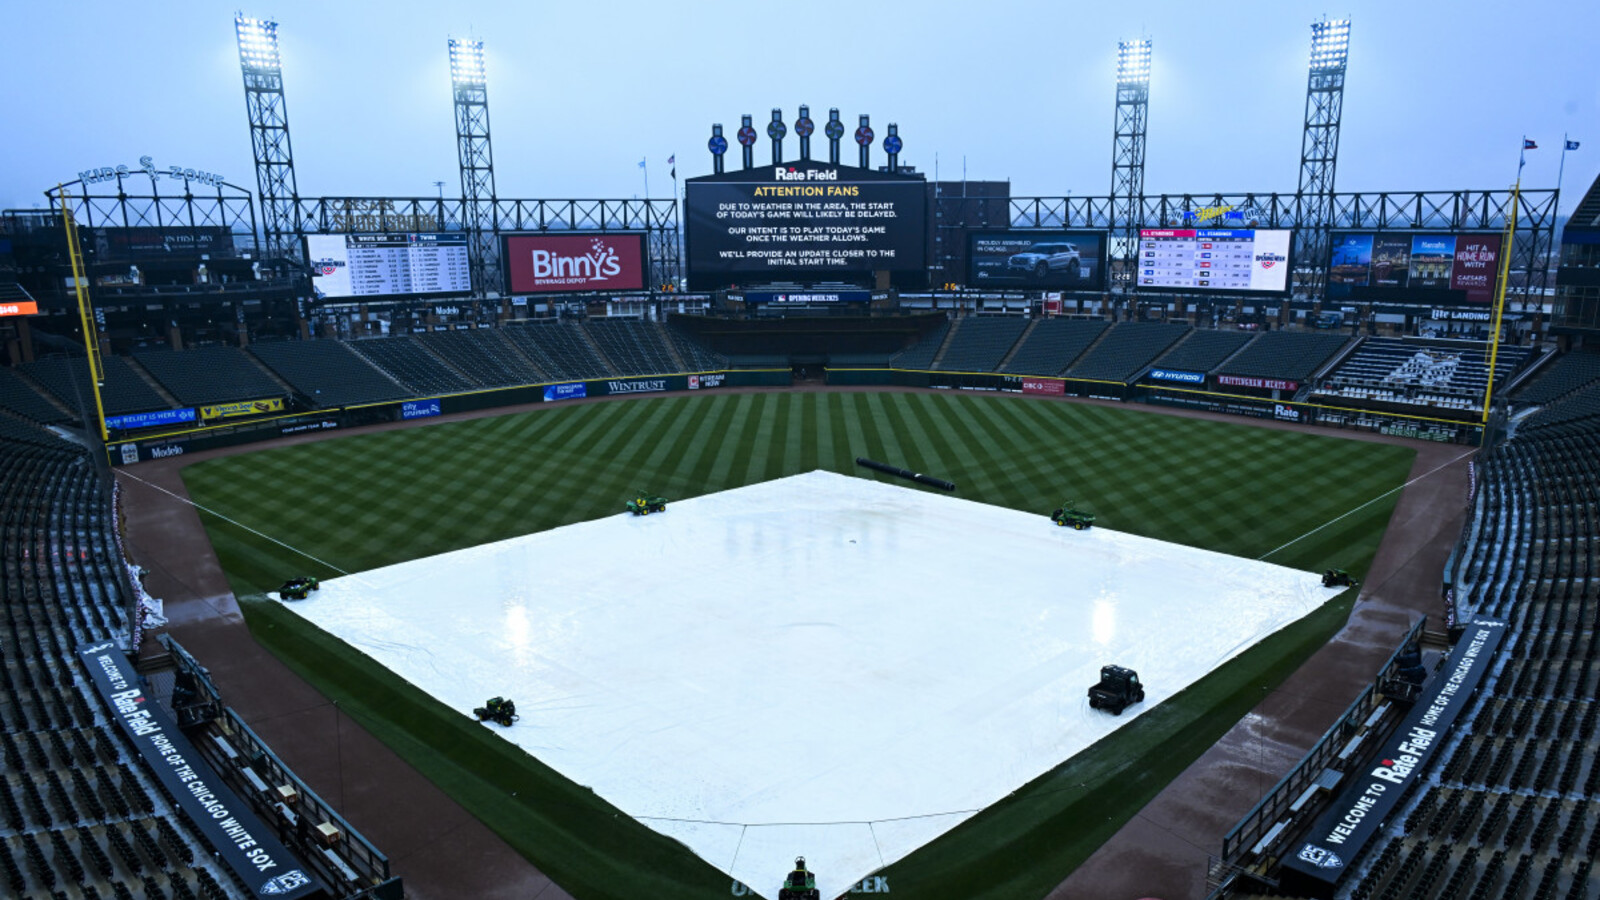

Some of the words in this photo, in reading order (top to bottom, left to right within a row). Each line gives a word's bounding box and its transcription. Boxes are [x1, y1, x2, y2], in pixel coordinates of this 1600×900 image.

[78, 164, 130, 185] KIDS
[169, 166, 224, 188] ZONE
[776, 166, 805, 180] Rate
[807, 170, 836, 180] Field
[754, 186, 824, 196] ATTENTION
[827, 186, 860, 196] FANS
[332, 199, 395, 210] CAESARS
[333, 214, 438, 232] SPORTSBOOK
[532, 247, 621, 280] Binny's
[1457, 252, 1478, 261] HOME
[1479, 252, 1495, 262] RUN
[1452, 312, 1490, 320] LANDING
[1165, 373, 1200, 382] HYUNDAI
[609, 380, 666, 392] WINTRUST
[1264, 380, 1286, 390] MEATS
[404, 409, 430, 417] cruises
[1275, 404, 1299, 418] Rate
[123, 415, 147, 423] RELIEF
[152, 445, 183, 458] Modelo
[1474, 629, 1490, 641] SOX
[1464, 640, 1485, 657] WHITE
[97, 654, 123, 682] WELCOME
[1450, 657, 1475, 684] CHICAGO
[113, 680, 128, 690] TO
[1441, 682, 1460, 696] THE
[110, 688, 142, 714] Rate
[1434, 695, 1450, 706] OF
[1420, 704, 1445, 726] HOME
[124, 709, 162, 736] Field
[150, 733, 177, 756] HOME
[1398, 726, 1437, 757] Field
[166, 754, 186, 765] OF
[174, 764, 198, 782] THE
[1370, 754, 1419, 784] Rate
[1365, 783, 1386, 797] TO
[188, 781, 229, 819] CHICAGO
[1326, 796, 1376, 844] WELCOME
[219, 817, 257, 851] WHITE
[246, 848, 277, 872] SOX
